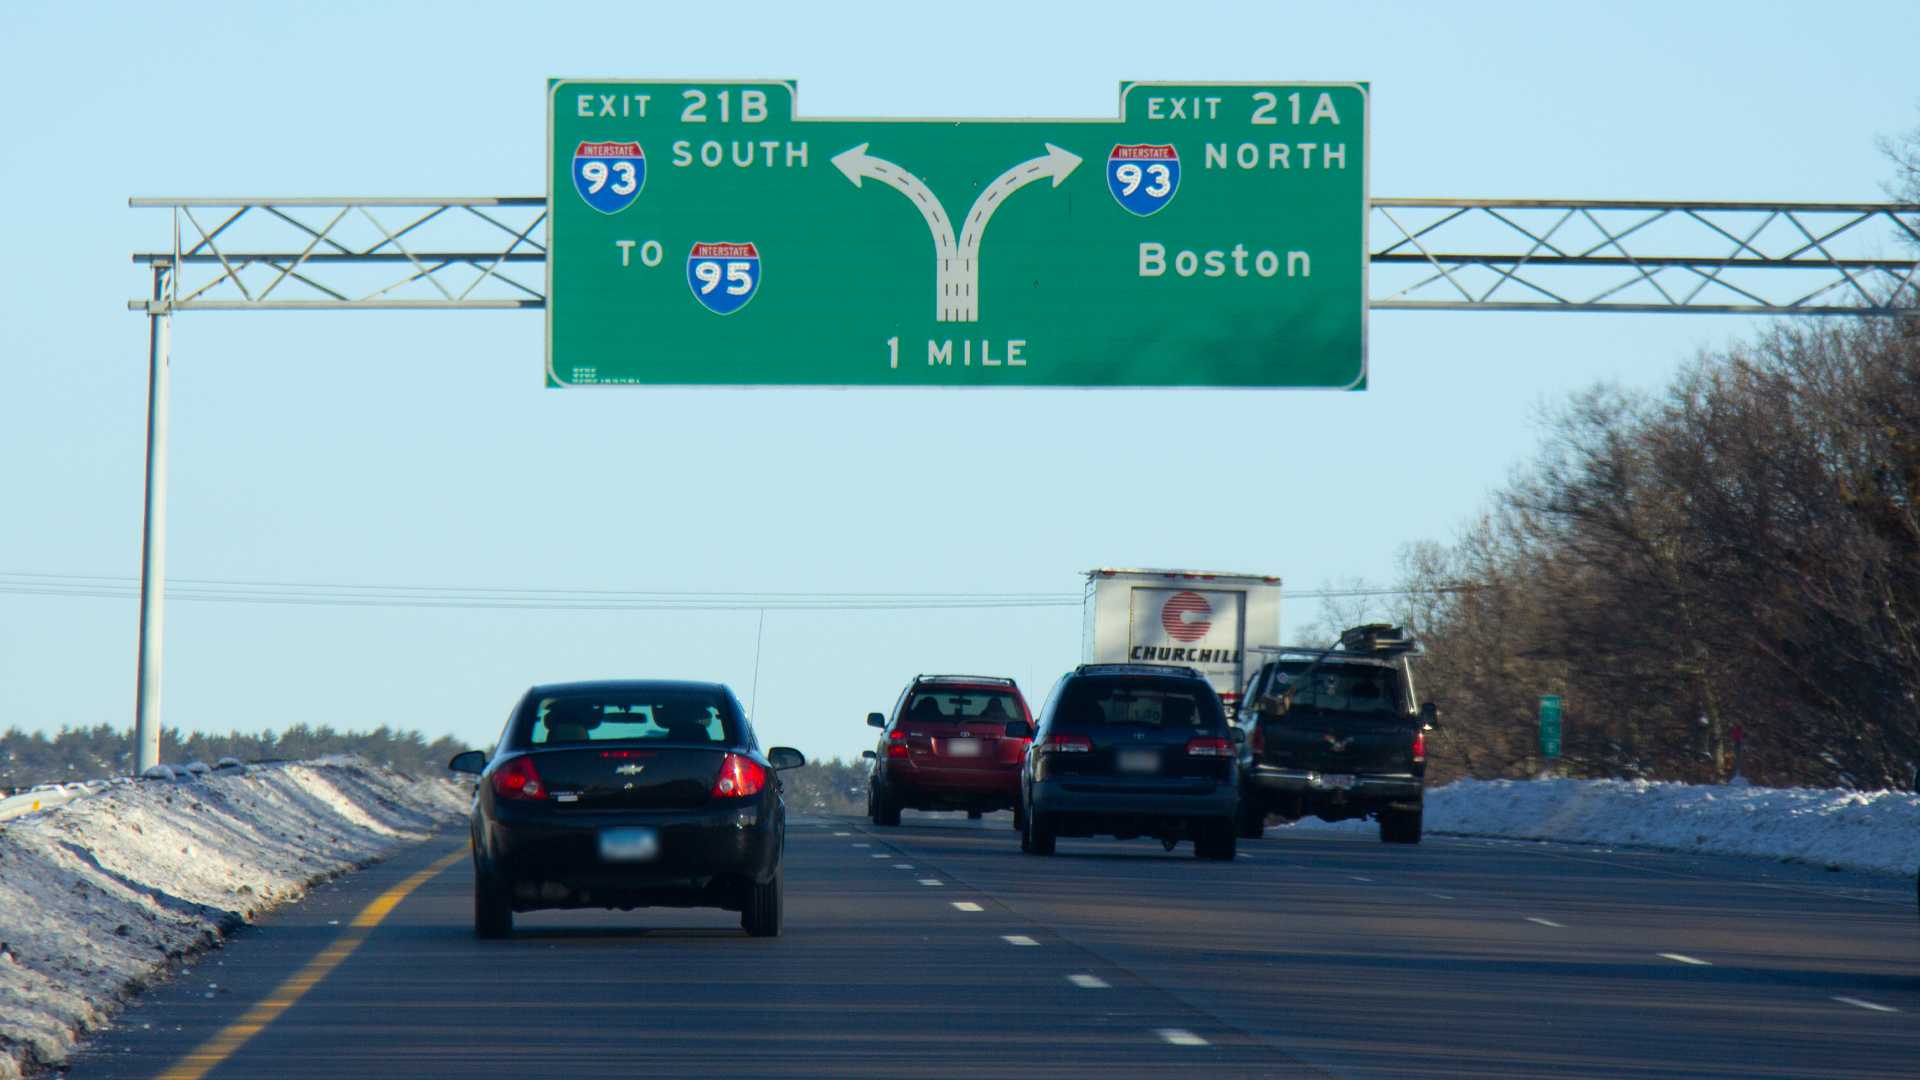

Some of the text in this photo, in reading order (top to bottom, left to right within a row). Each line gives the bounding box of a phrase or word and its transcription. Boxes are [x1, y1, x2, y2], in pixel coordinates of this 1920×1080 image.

[577, 89, 768, 123] EXIT 21B
[1148, 91, 1341, 125] EXIT 21A
[584, 146, 635, 157] INTERSTATE
[672, 140, 809, 168] SOUTH
[1118, 148, 1169, 158] INTERSTATE
[1205, 142, 1346, 170] NORTH
[582, 161, 637, 196] 93
[1116, 164, 1171, 198] 93
[616, 240, 663, 267] TO
[699, 246, 749, 257] INTERSTATE
[1138, 242, 1311, 278] Boston
[695, 261, 753, 296] 95
[887, 336, 1028, 369] 1 MILE
[1131, 645, 1242, 664] CHURCHILL
